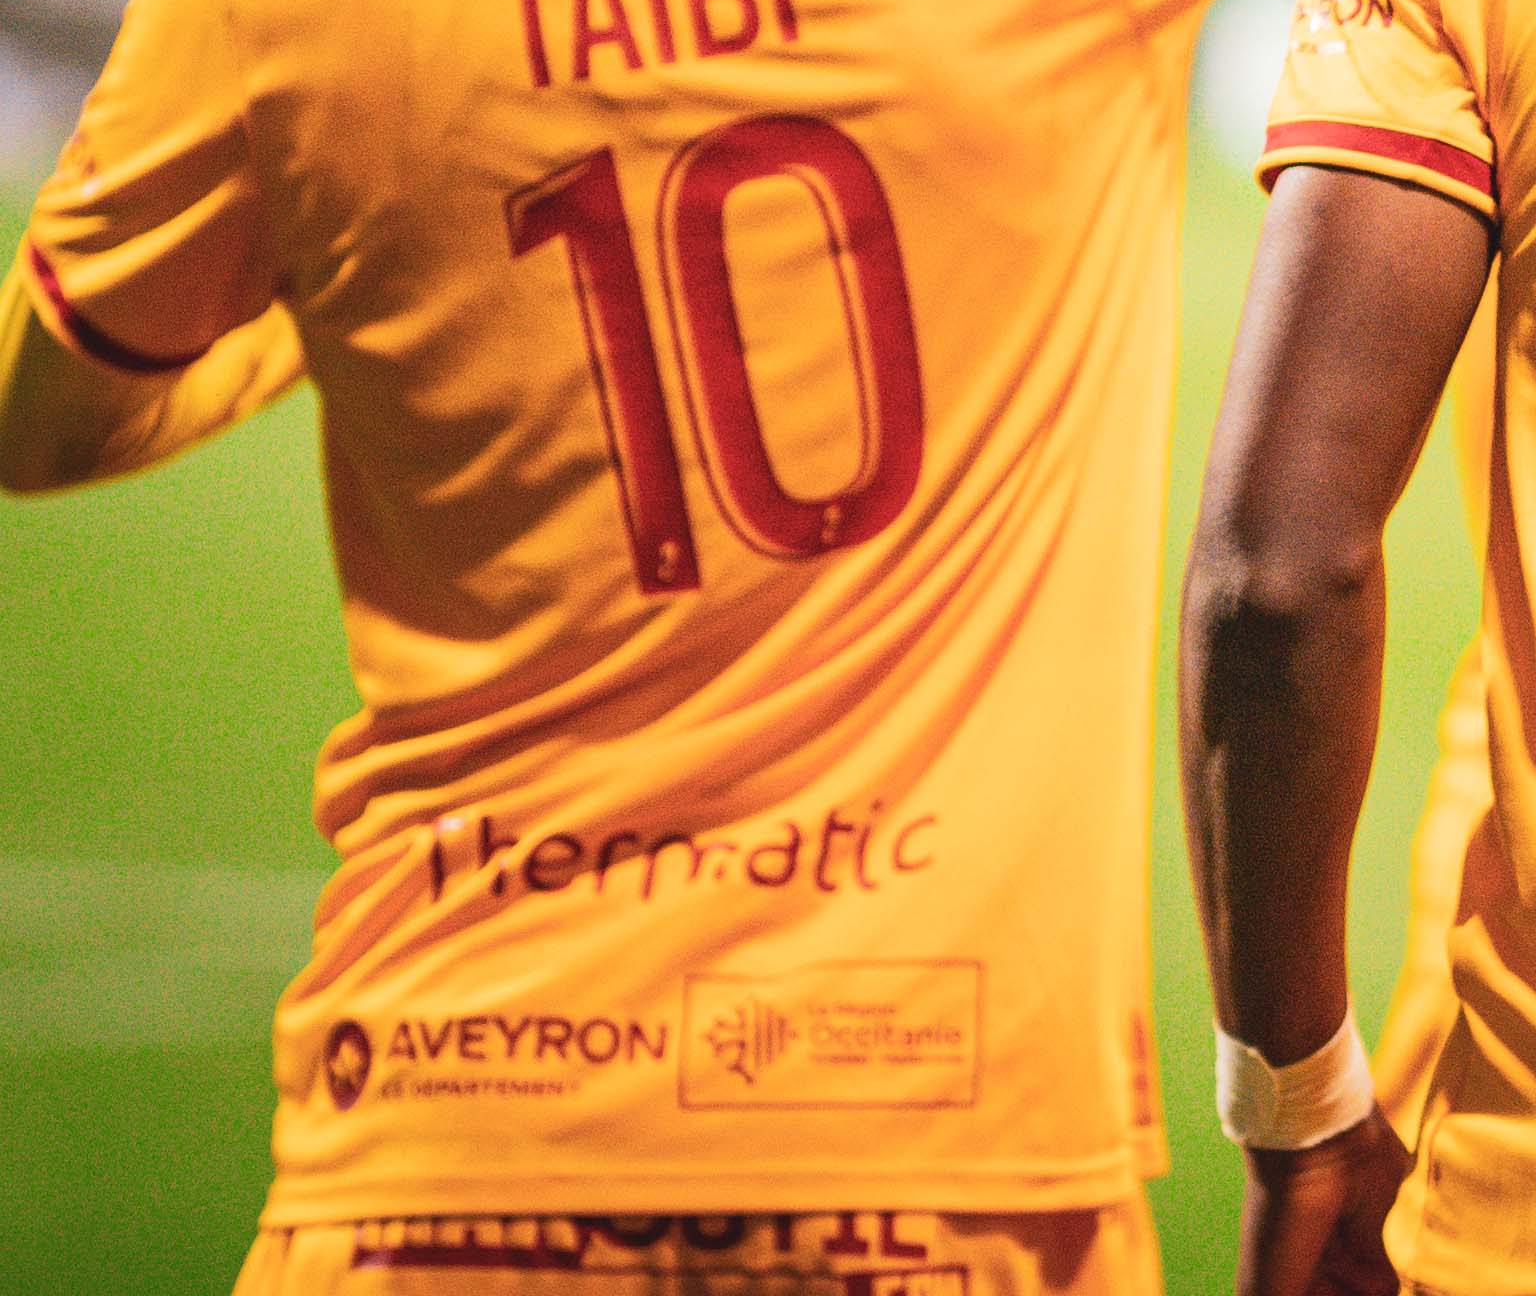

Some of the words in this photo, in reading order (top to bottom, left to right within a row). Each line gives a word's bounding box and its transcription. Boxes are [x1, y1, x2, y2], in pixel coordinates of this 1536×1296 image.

[504, 115, 926, 595] 10
[430, 800, 938, 903] Thermatic
[387, 1014, 668, 1064] AVEYRON
